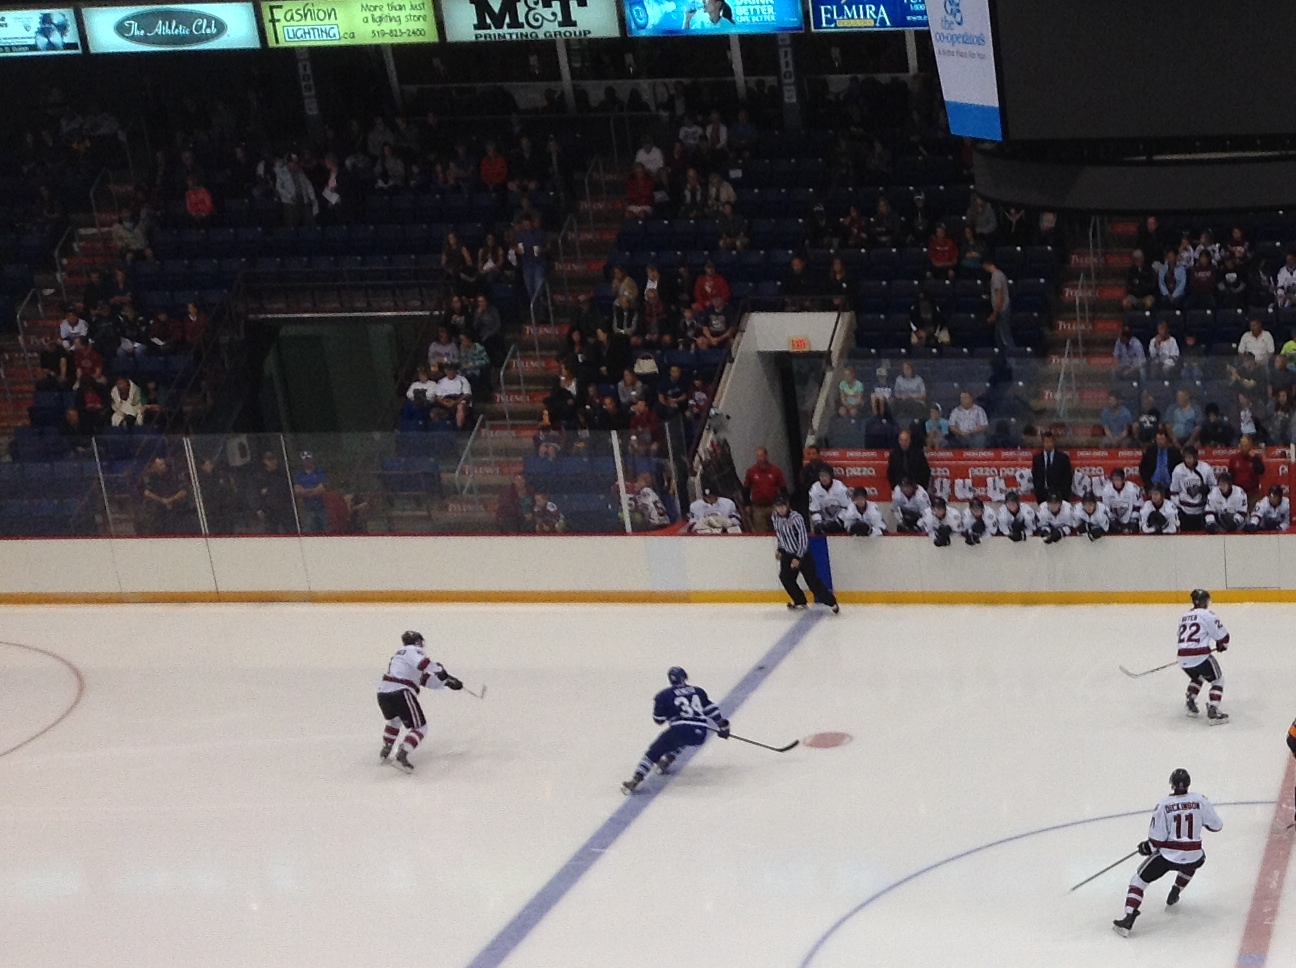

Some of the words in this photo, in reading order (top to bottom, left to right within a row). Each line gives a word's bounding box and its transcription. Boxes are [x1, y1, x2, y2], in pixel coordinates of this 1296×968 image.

[361, 3, 383, 12] More
[387, 1, 406, 11] than
[469, 0, 588, 30] M&T
[820, 4, 892, 27] ELMIRA
[124, 21, 144, 36] The
[147, 20, 189, 36] Athletic
[192, 18, 217, 34] Club
[268, 4, 338, 45] Fashion
[405, 13, 428, 23] store
[286, 27, 337, 40] LIGHTING
[475, 31, 540, 41] PRINTING
[544, 30, 592, 39] GROUP
[845, 467, 876, 478] pizza
[1178, 622, 1200, 644] 22
[674, 694, 704, 718] 34
[1173, 813, 1193, 840] 11
